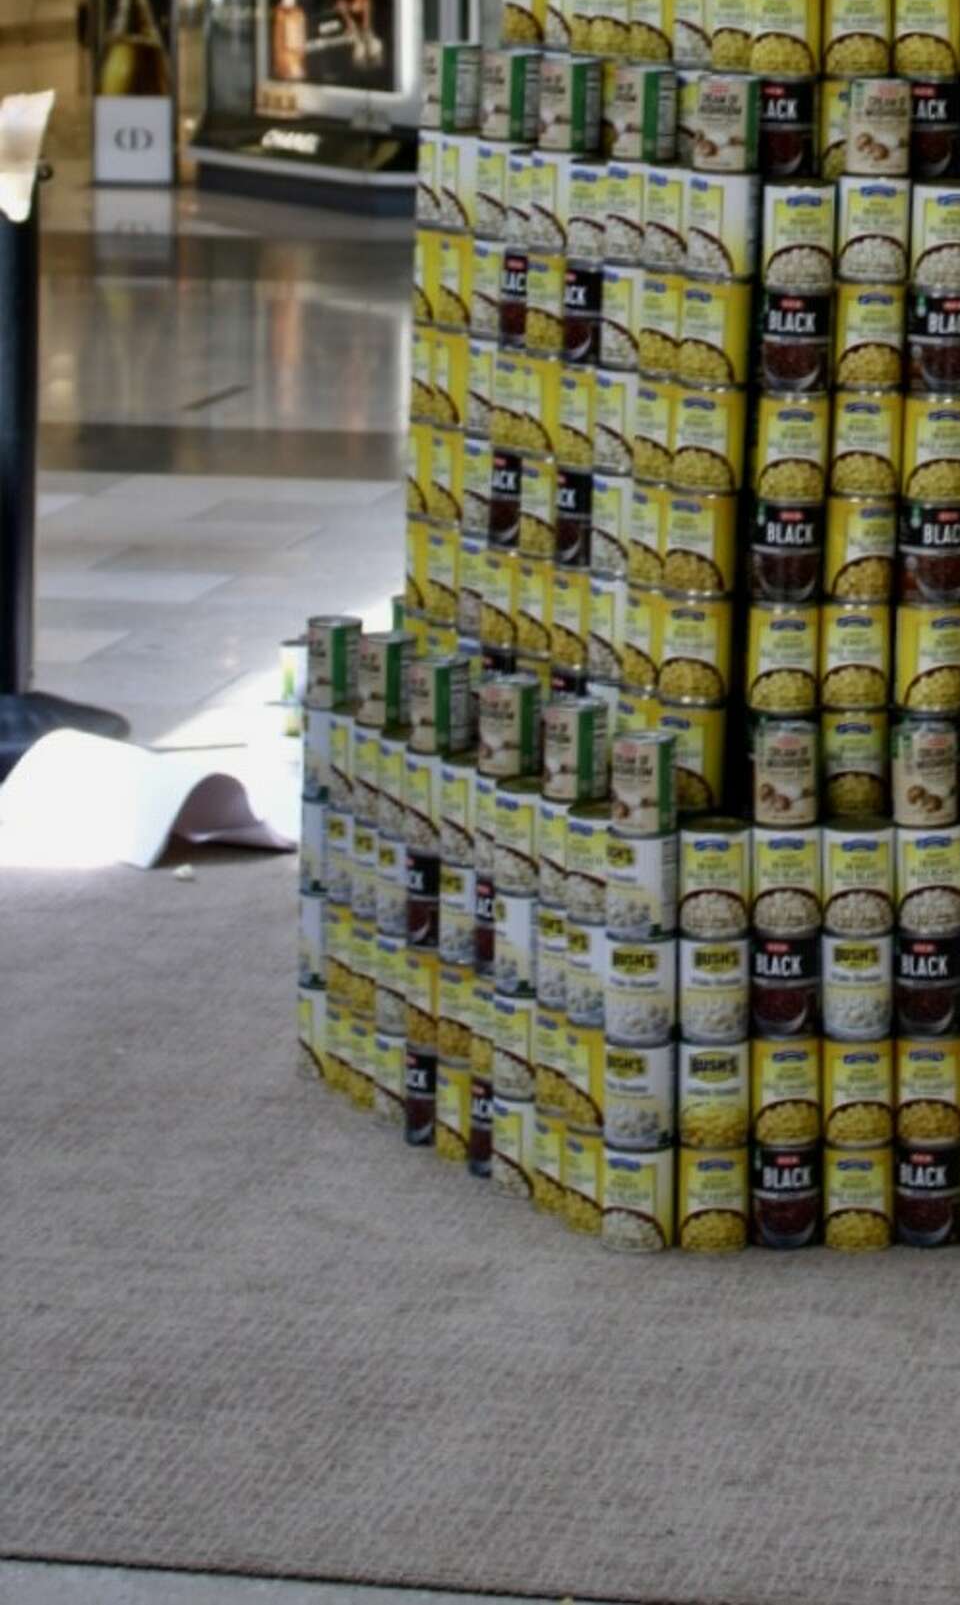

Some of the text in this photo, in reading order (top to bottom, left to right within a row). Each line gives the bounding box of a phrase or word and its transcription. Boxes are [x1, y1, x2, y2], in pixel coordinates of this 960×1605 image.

[765, 98, 798, 120] ACK
[916, 99, 948, 120] ACK
[768, 309, 817, 334] BLACK
[766, 522, 814, 546] BLACK
[754, 952, 803, 978] BLACK
[900, 953, 948, 978] BLACK
[762, 1165, 812, 1189] BLACK
[899, 1163, 947, 1188] BLACK
